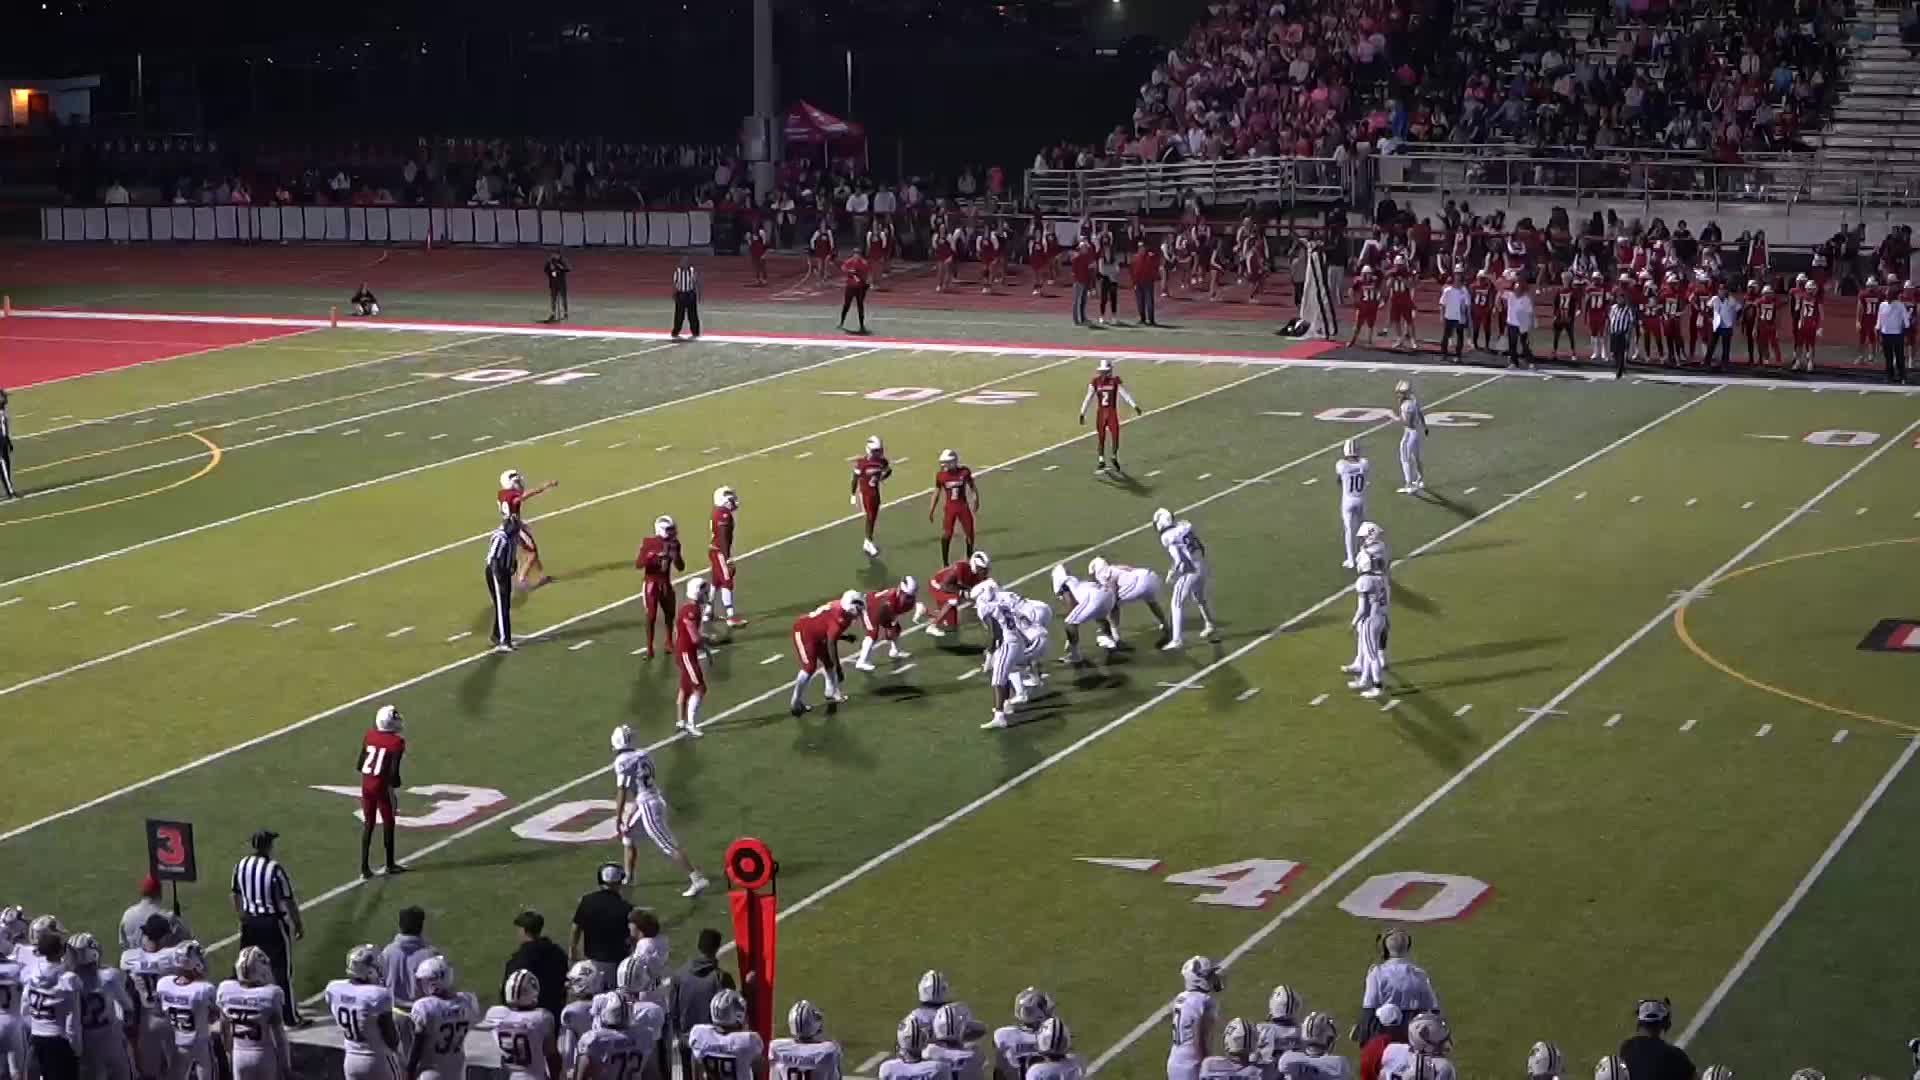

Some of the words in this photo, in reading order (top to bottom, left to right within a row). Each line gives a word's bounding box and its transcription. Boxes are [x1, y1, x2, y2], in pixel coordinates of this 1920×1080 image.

[1101, 391, 1109, 406] 2
[1349, 473, 1365, 494] 10
[366, 745, 386, 776] 21
[155, 823, 186, 867] 3
[1163, 857, 1499, 924] 40
[338, 1005, 361, 1042] 91
[499, 1031, 532, 1065] 50
